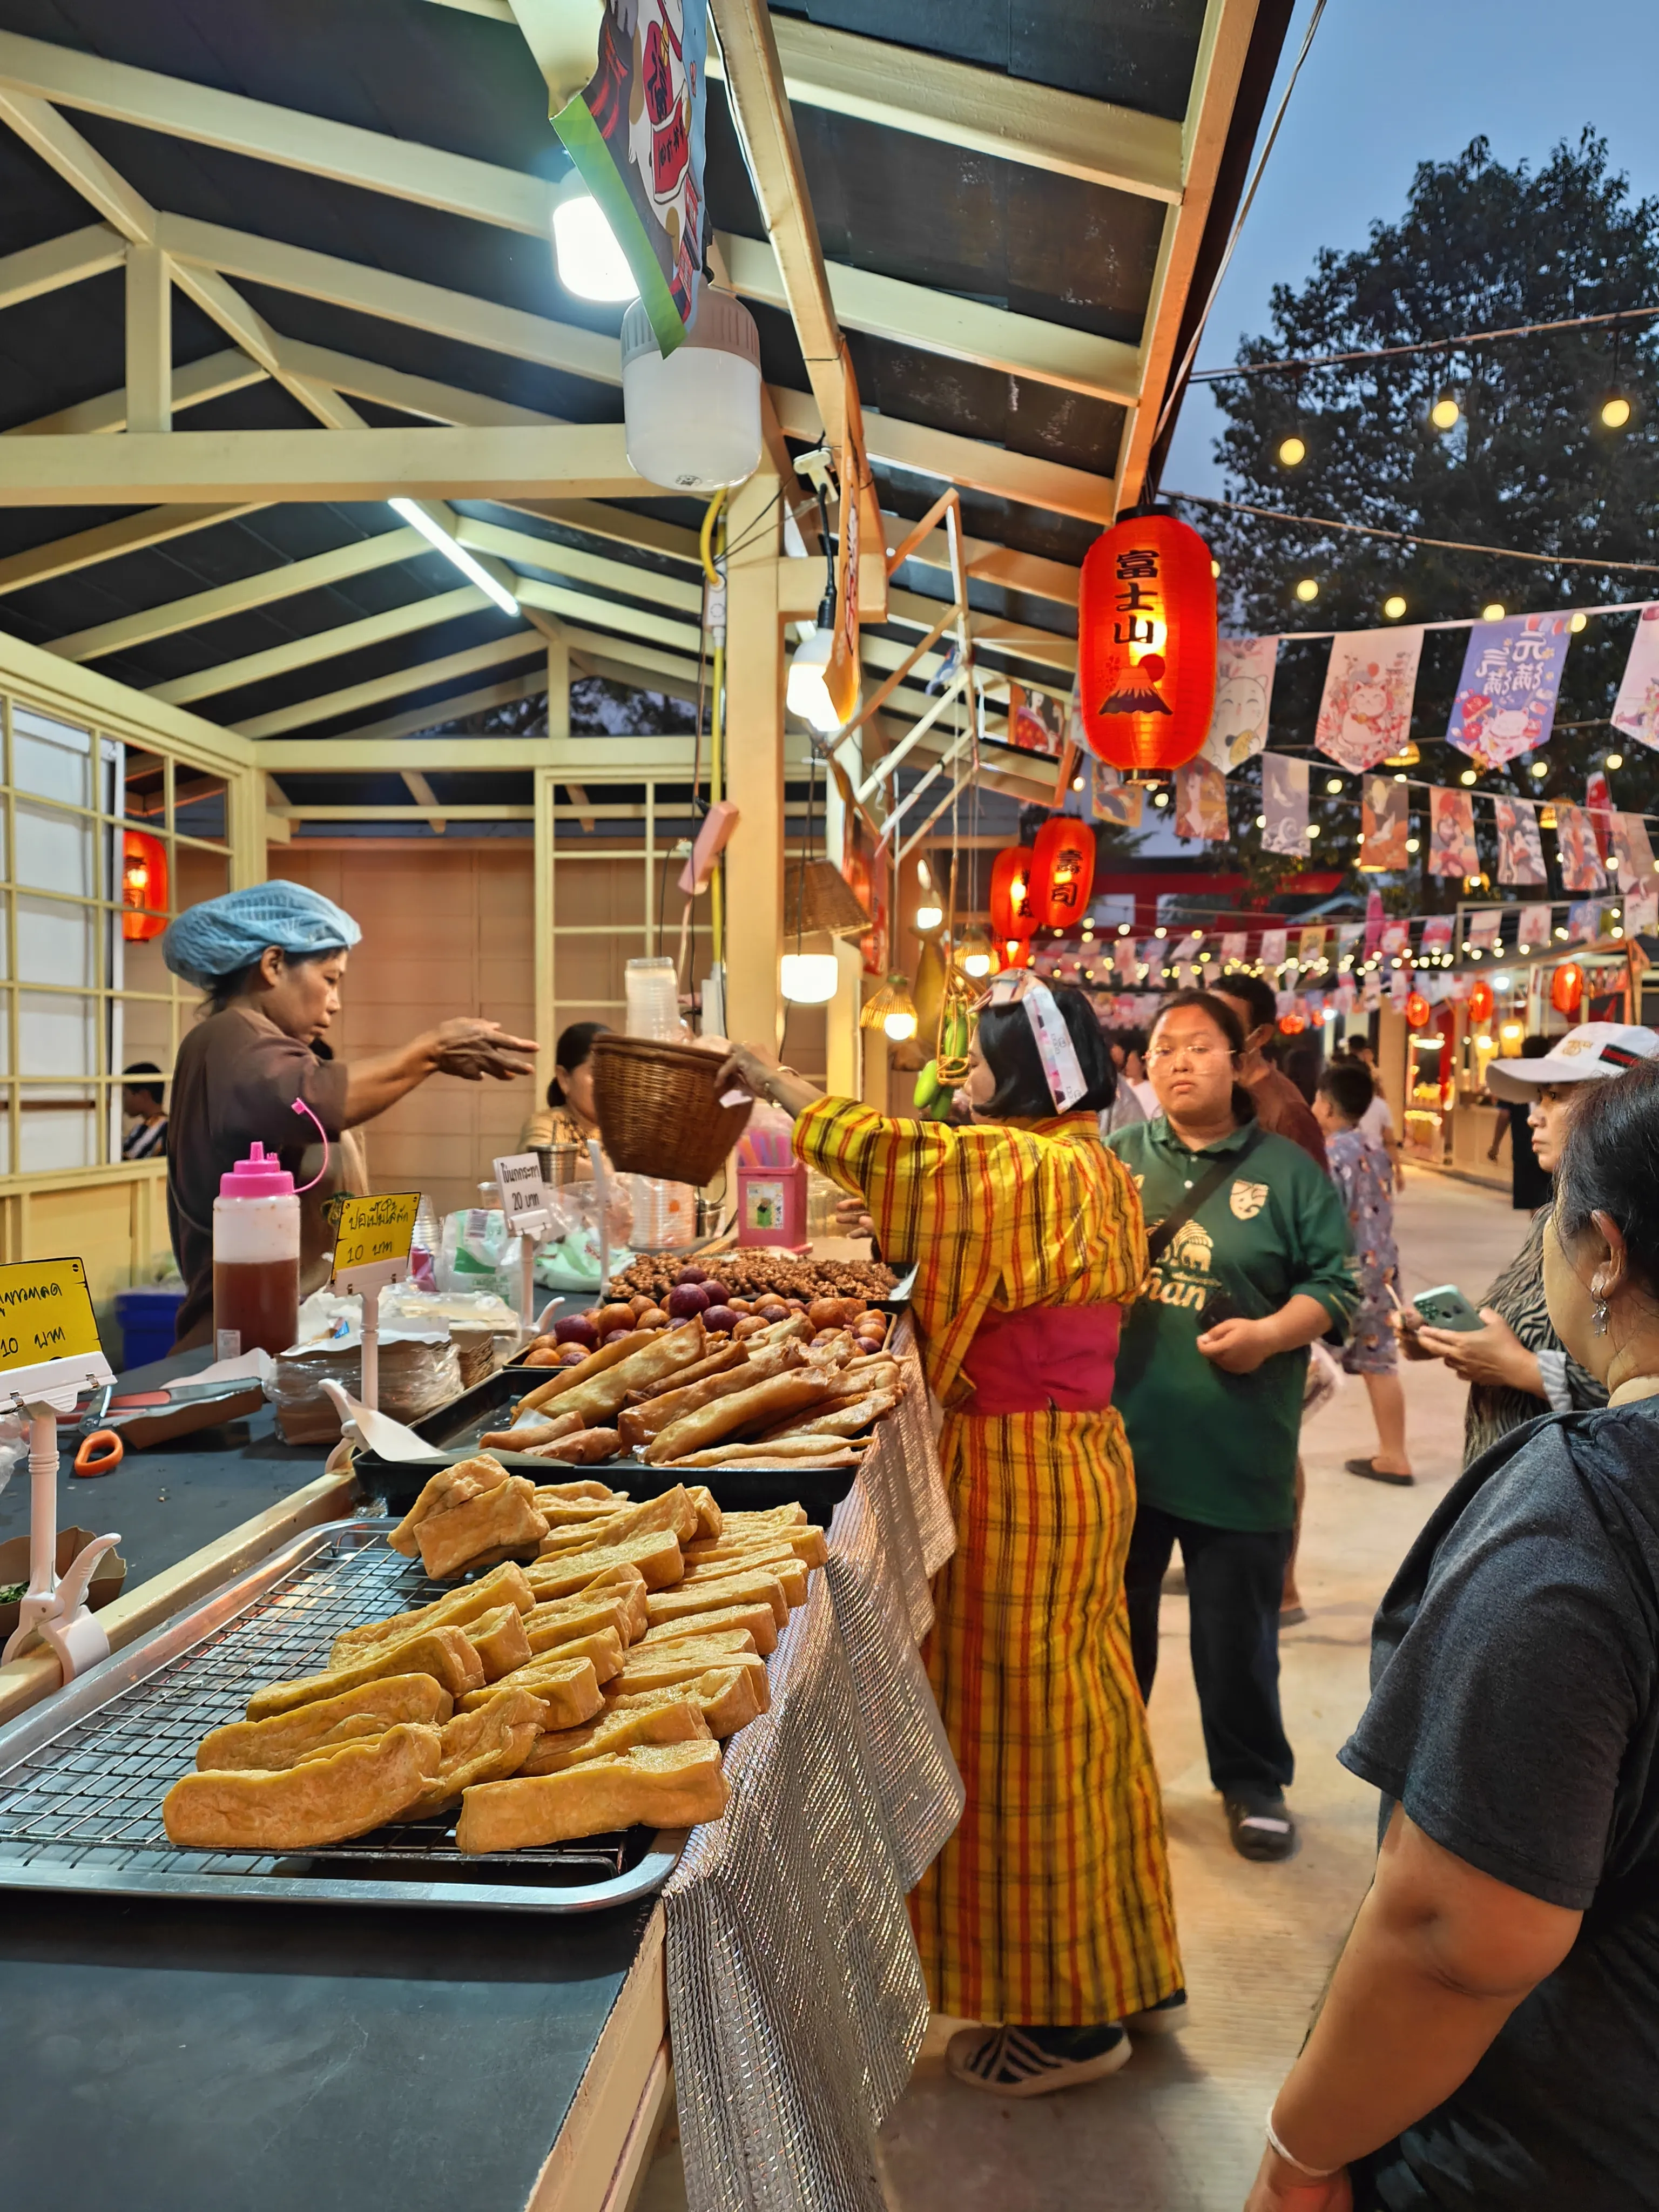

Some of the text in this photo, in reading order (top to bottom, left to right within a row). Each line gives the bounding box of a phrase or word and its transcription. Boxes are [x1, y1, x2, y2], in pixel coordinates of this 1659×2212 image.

[1114, 550, 1159, 644] 富士山
[511, 1191, 540, 1211] 20 บาท
[347, 1241, 393, 1264] 10 บาท
[1, 1326, 65, 1357] 10 บาท
